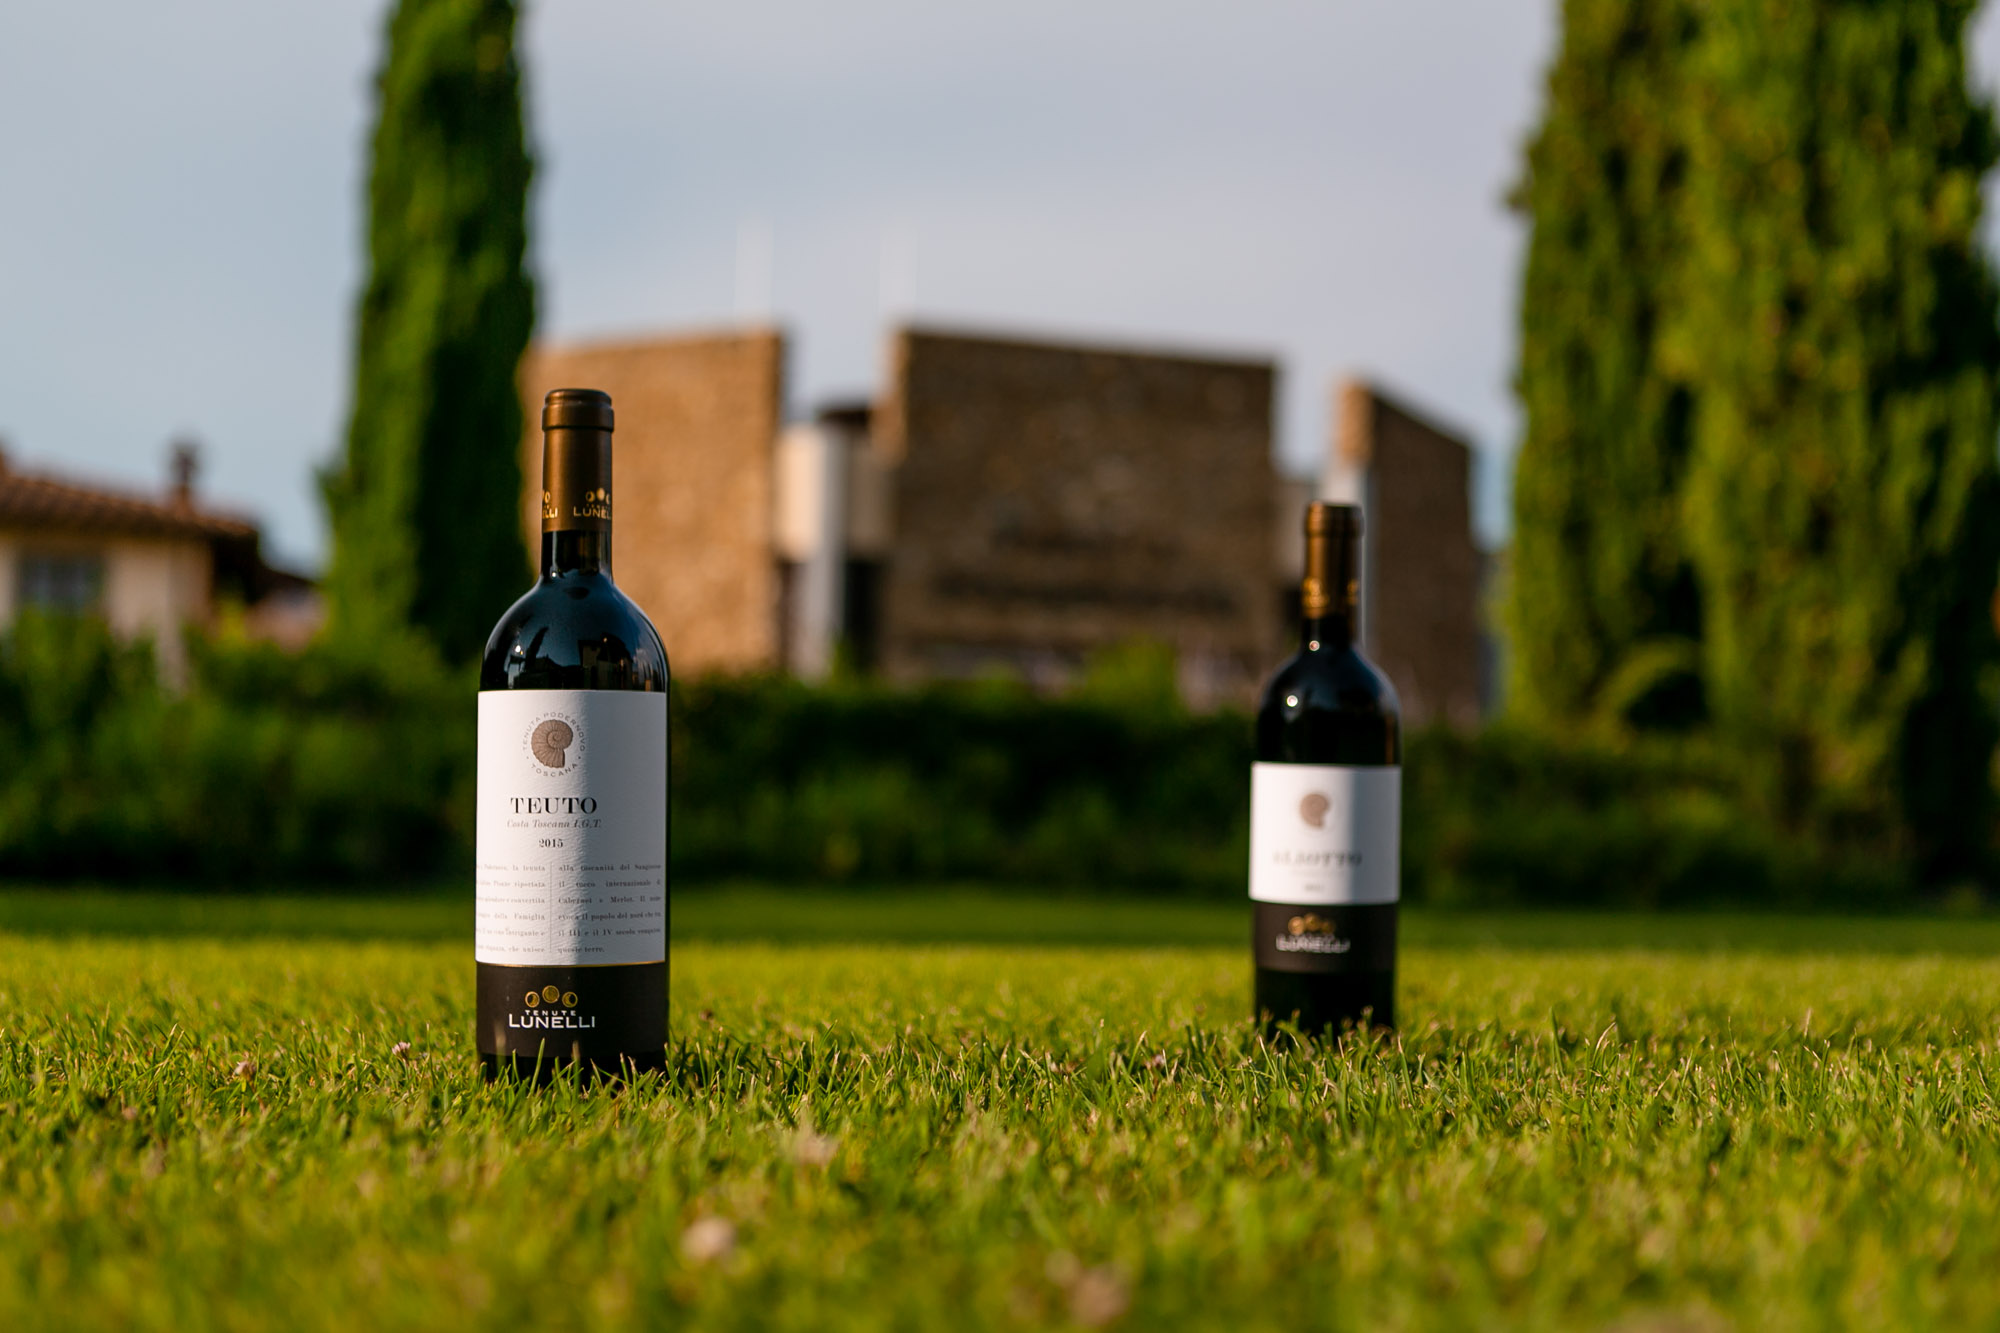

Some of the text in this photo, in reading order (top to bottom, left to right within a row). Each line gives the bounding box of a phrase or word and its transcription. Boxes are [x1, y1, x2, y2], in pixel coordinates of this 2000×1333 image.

[523, 711, 586, 753] TENUTA PODERNOVO
[531, 762, 578, 778] TOSCANA
[510, 797, 598, 815] TEUTO
[507, 819, 529, 829] Costa
[532, 819, 570, 829] Toscana
[538, 838, 564, 848] 2015
[523, 864, 546, 872] tenuta
[619, 863, 630, 871] del
[558, 896, 592, 904] Cabernet
[514, 912, 546, 921] Famiglia
[591, 912, 615, 922] popolo
[508, 1013, 596, 1029] LUNELLI
